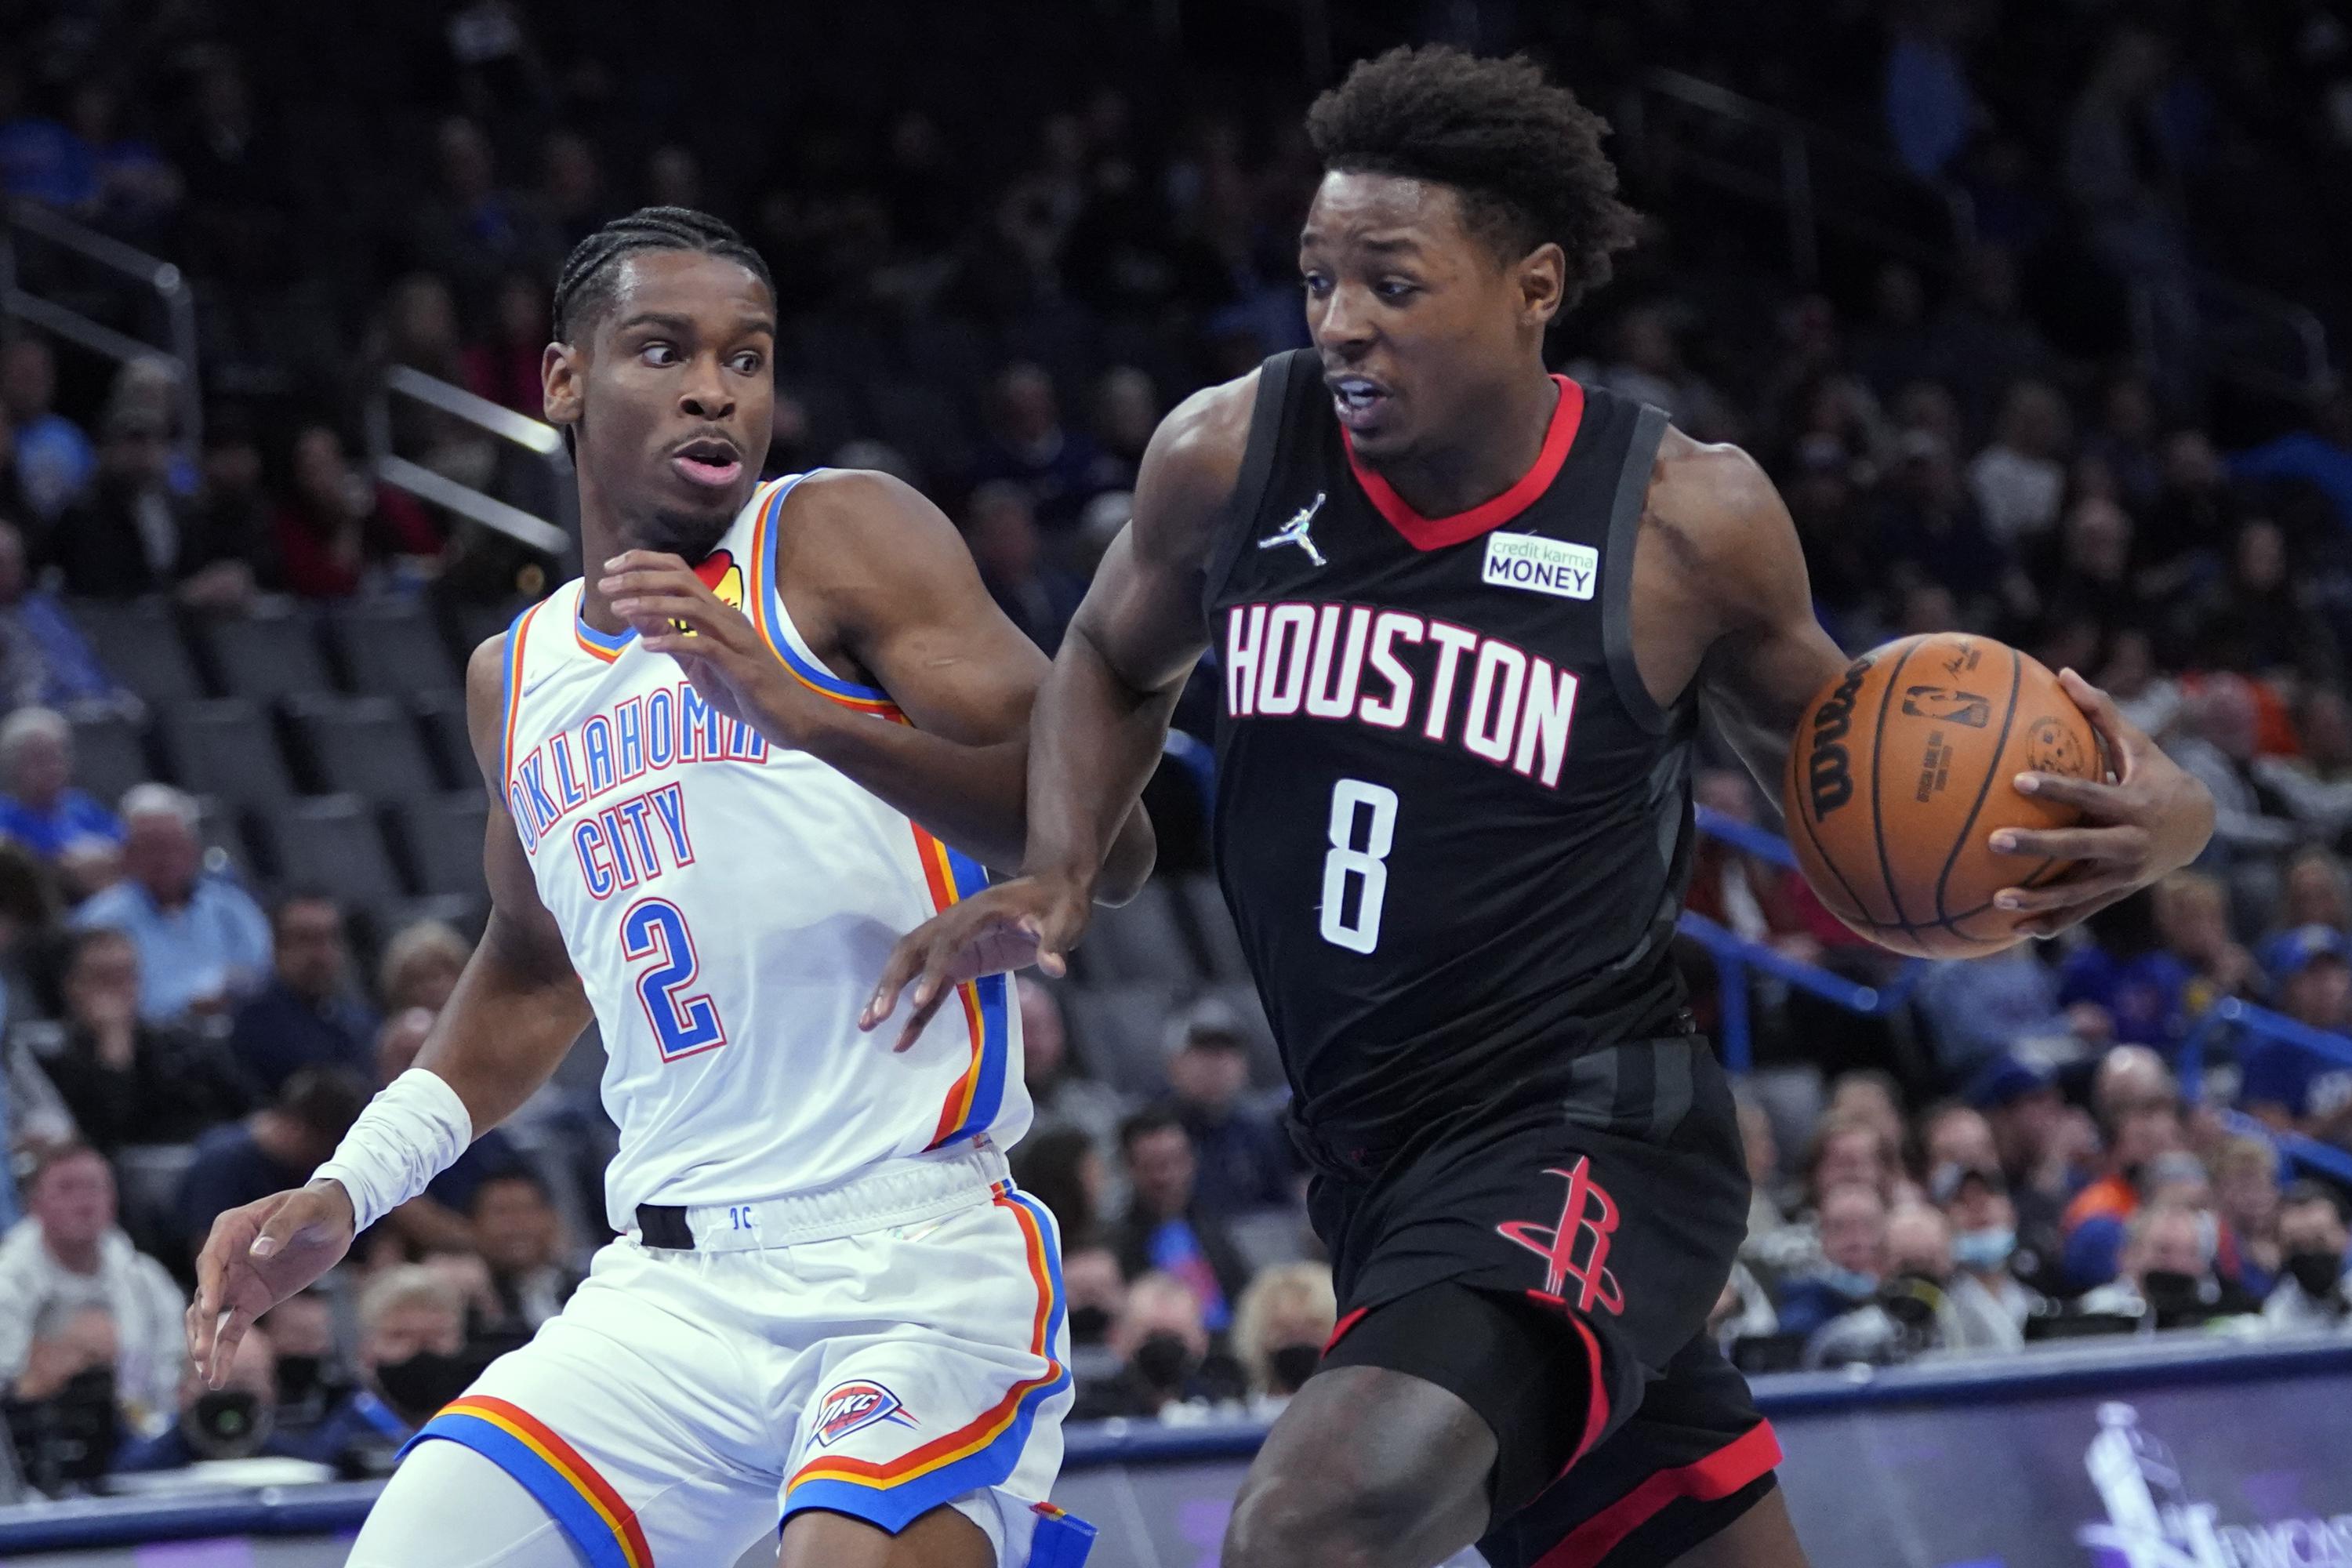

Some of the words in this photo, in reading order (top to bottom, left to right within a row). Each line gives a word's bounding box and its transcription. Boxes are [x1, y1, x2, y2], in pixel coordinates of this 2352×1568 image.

[1490, 555, 1591, 592] MONEY
[1493, 541, 1541, 559] credit
[1543, 546, 1594, 569] karma
[1228, 602, 1582, 789] HOUSTON
[572, 781, 695, 900] CITY
[1319, 778, 1399, 955] 8
[619, 896, 727, 1063] 2
